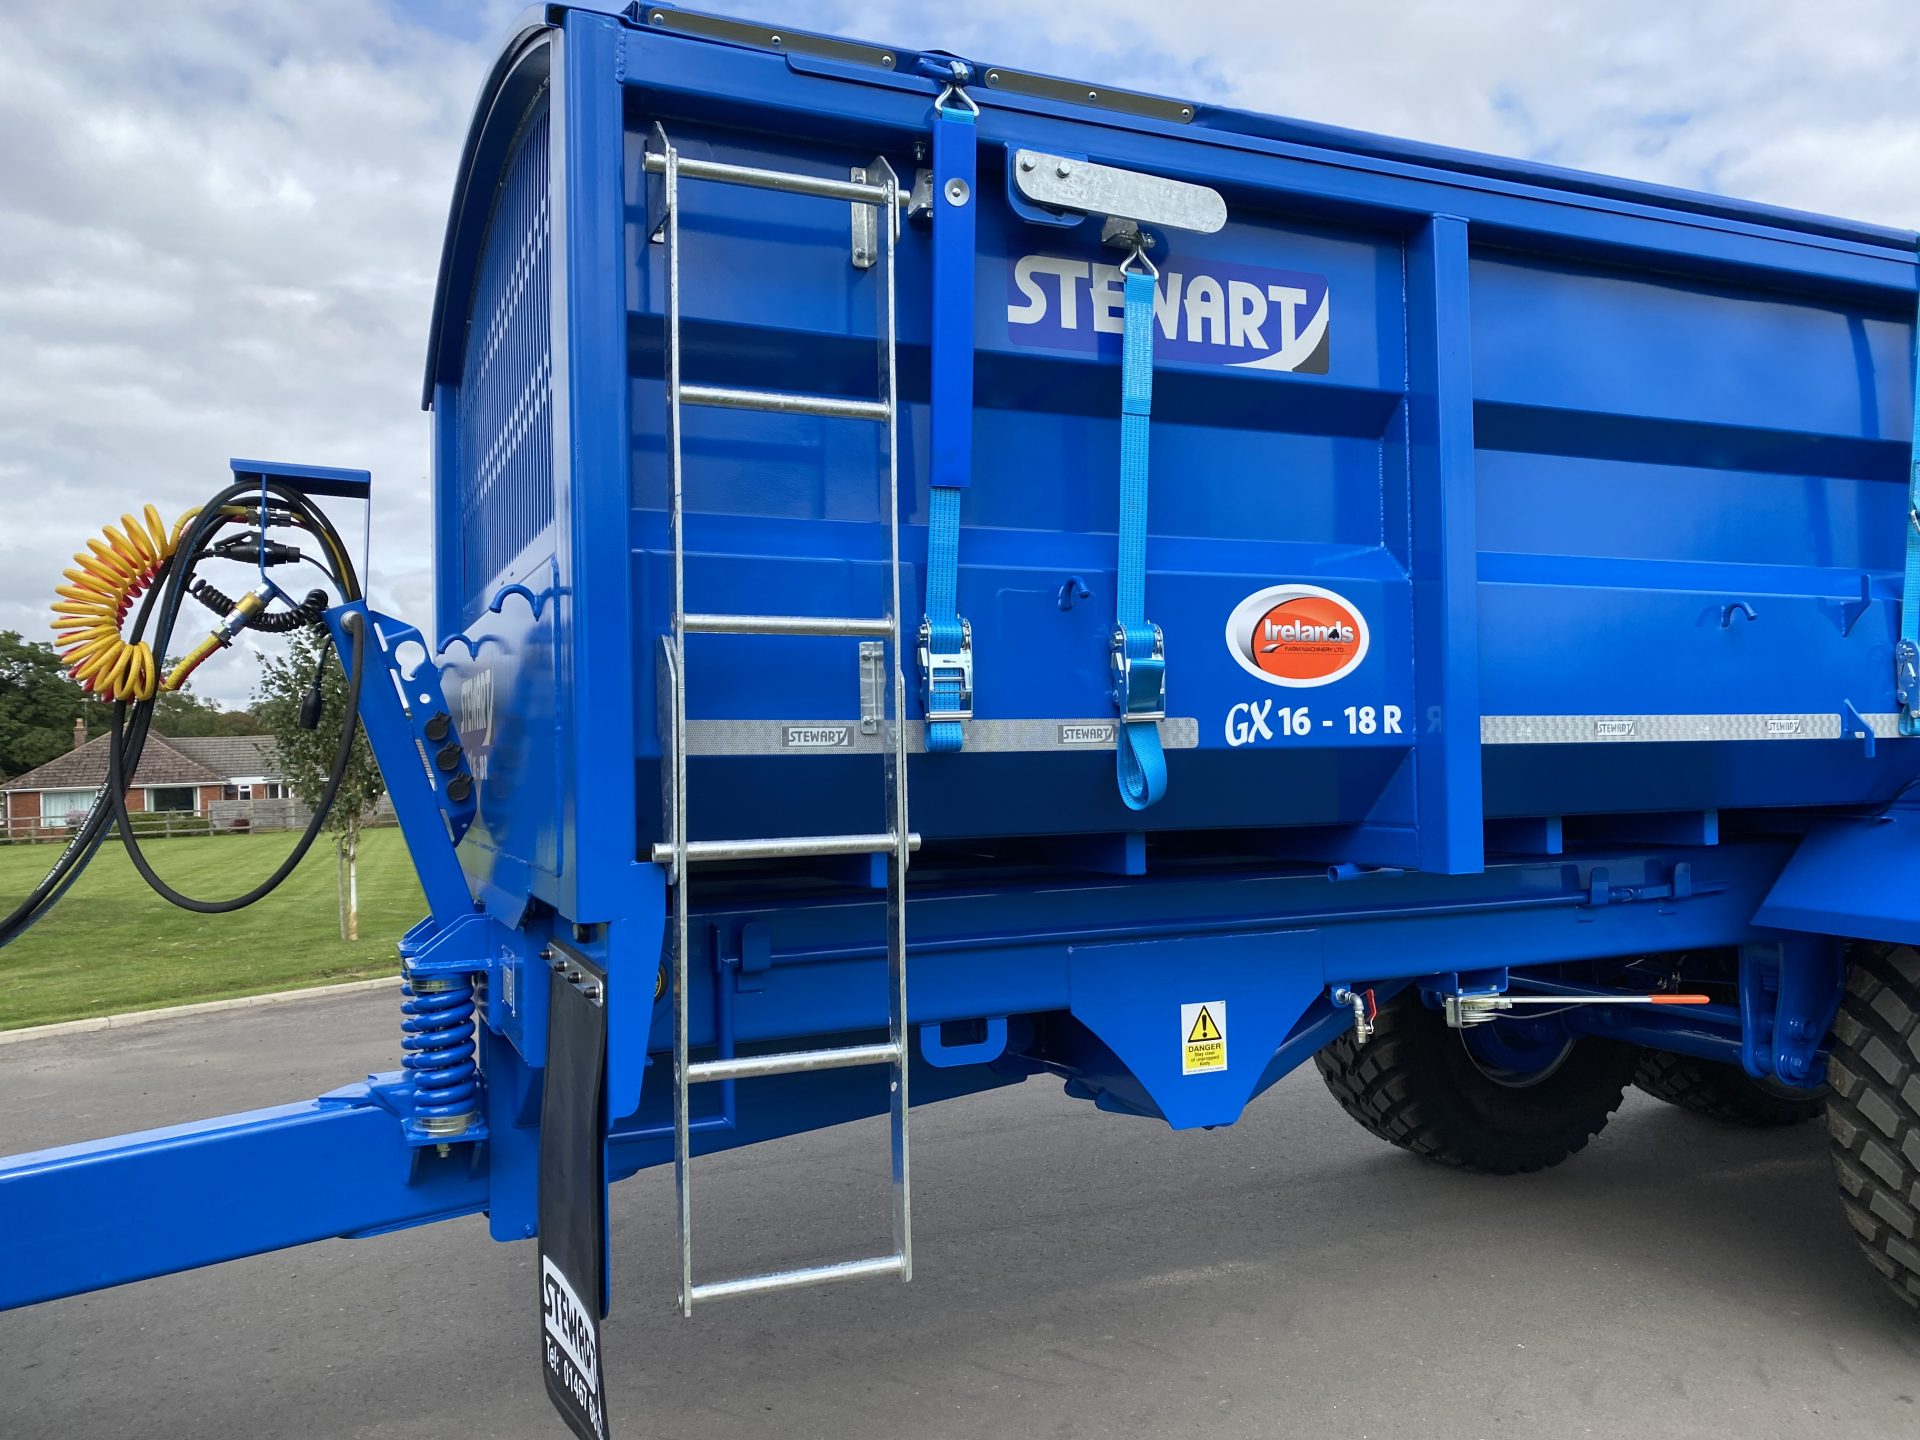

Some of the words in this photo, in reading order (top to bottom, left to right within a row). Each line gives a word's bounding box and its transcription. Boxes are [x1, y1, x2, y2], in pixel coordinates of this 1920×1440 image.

[1265, 619, 1354, 643] Irelands
[1225, 699, 1273, 747] GX
[1278, 706, 1311, 735] 16
[1599, 723, 1633, 733] STEWART
[788, 730, 845, 743] STEWART
[1064, 728, 1111, 740] STEWART
[1189, 1043, 1221, 1053] DANGER
[546, 1335, 559, 1376] Tel:
[563, 1359, 588, 1411] 01467
